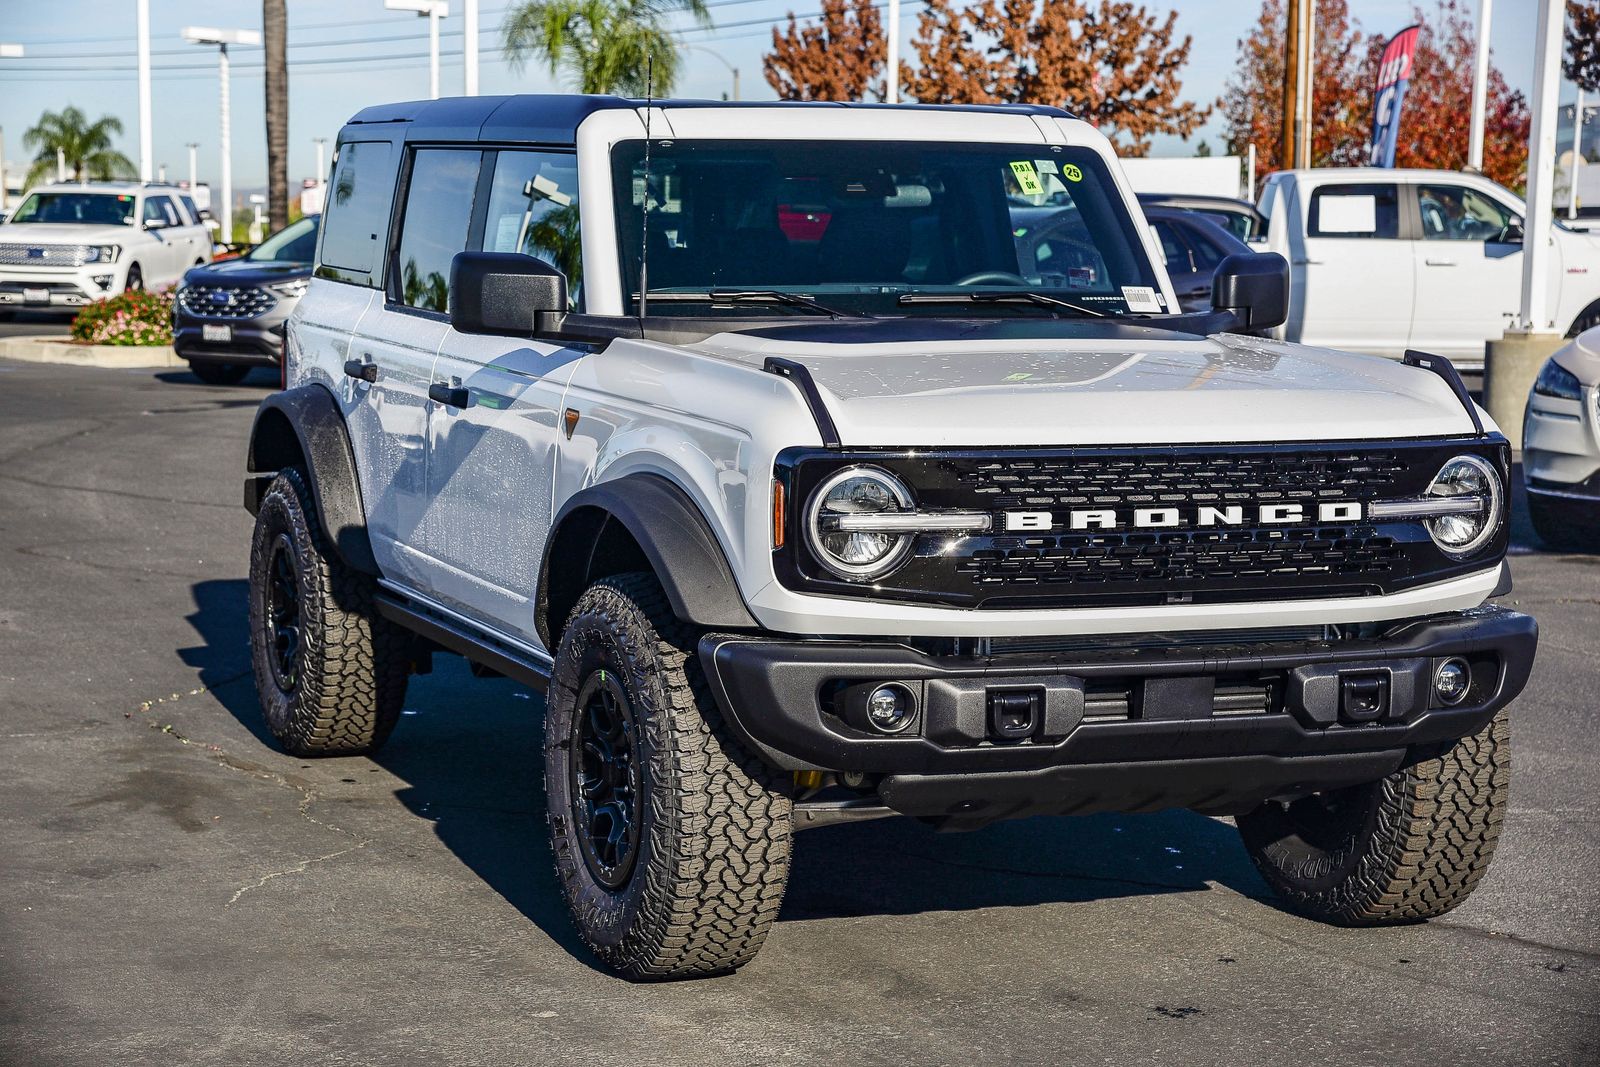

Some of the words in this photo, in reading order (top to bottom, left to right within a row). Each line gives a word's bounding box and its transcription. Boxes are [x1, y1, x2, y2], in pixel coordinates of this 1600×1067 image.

[1066, 166, 1080, 179] 25
[1025, 181, 1037, 190] OK
[1005, 502, 1362, 531] BRONCO
